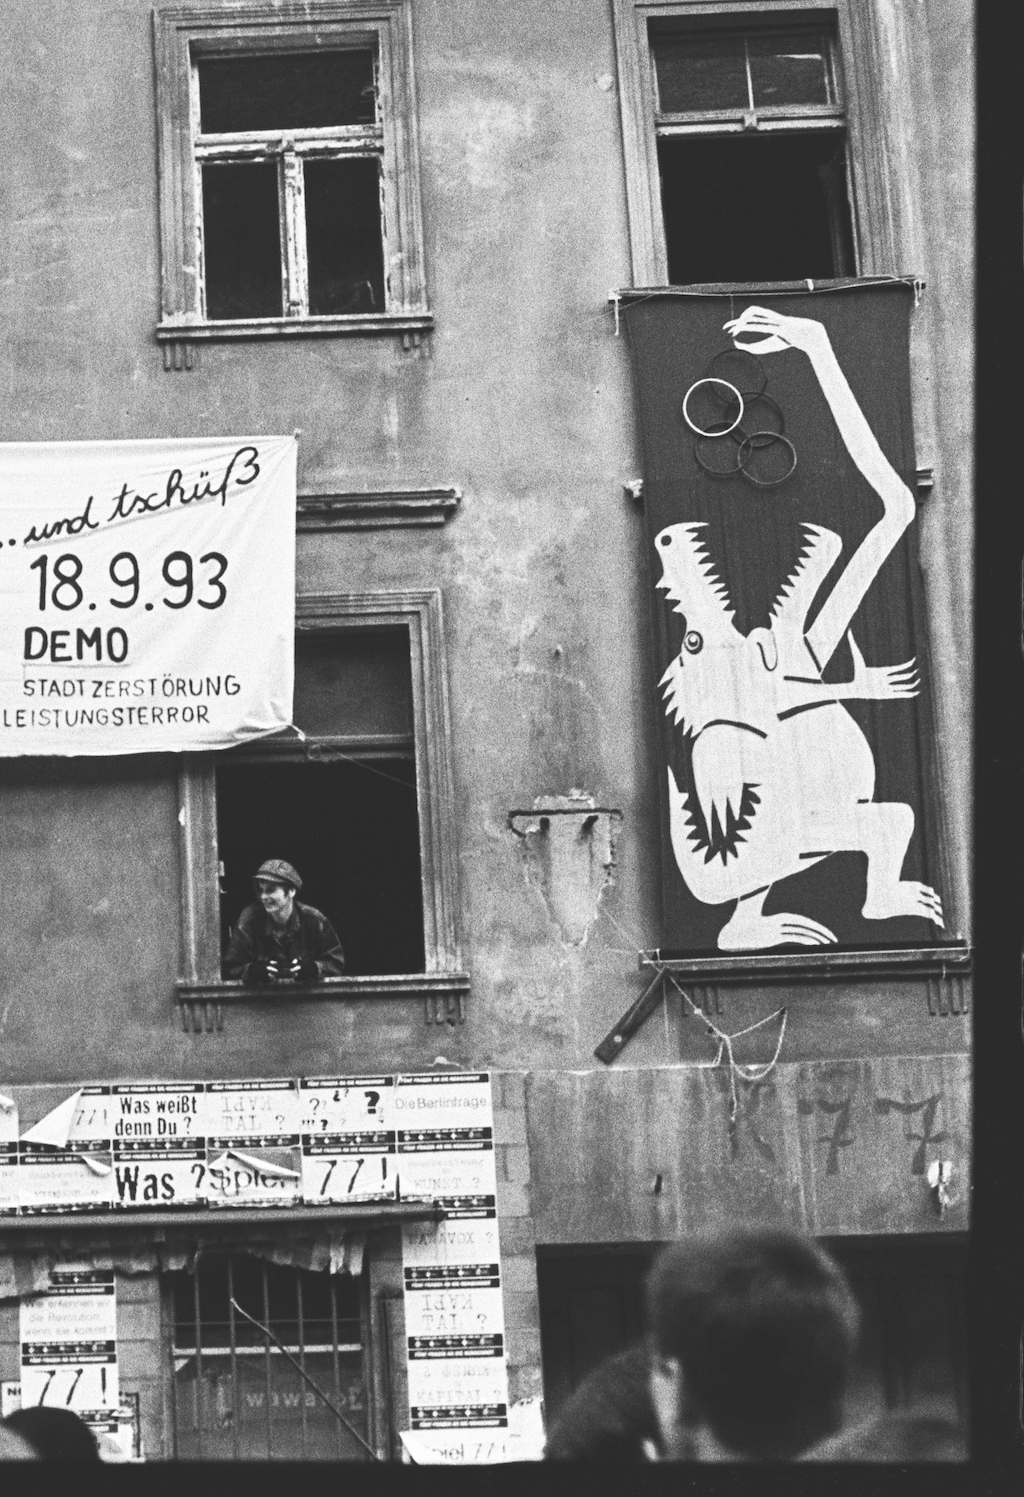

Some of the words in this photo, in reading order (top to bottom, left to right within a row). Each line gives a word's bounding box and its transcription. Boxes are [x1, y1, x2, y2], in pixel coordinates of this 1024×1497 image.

[29, 550, 229, 610] 18.9.93
[24, 627, 129, 663] DEMO
[0, 705, 209, 728] LEISTUNGSTERROR
[120, 1097, 150, 1114] Was
[157, 1095, 197, 1114] weißt
[115, 1118, 152, 1136] denn
[158, 1118, 177, 1135] Du
[184, 1116, 191, 1134] ?
[275, 1115, 285, 1130] ?
[115, 1166, 175, 1201] Was
[191, 1163, 206, 1189] ?
[315, 1159, 364, 1195] 77
[476, 1313, 487, 1330] ?
[34, 1369, 83, 1406] 77
